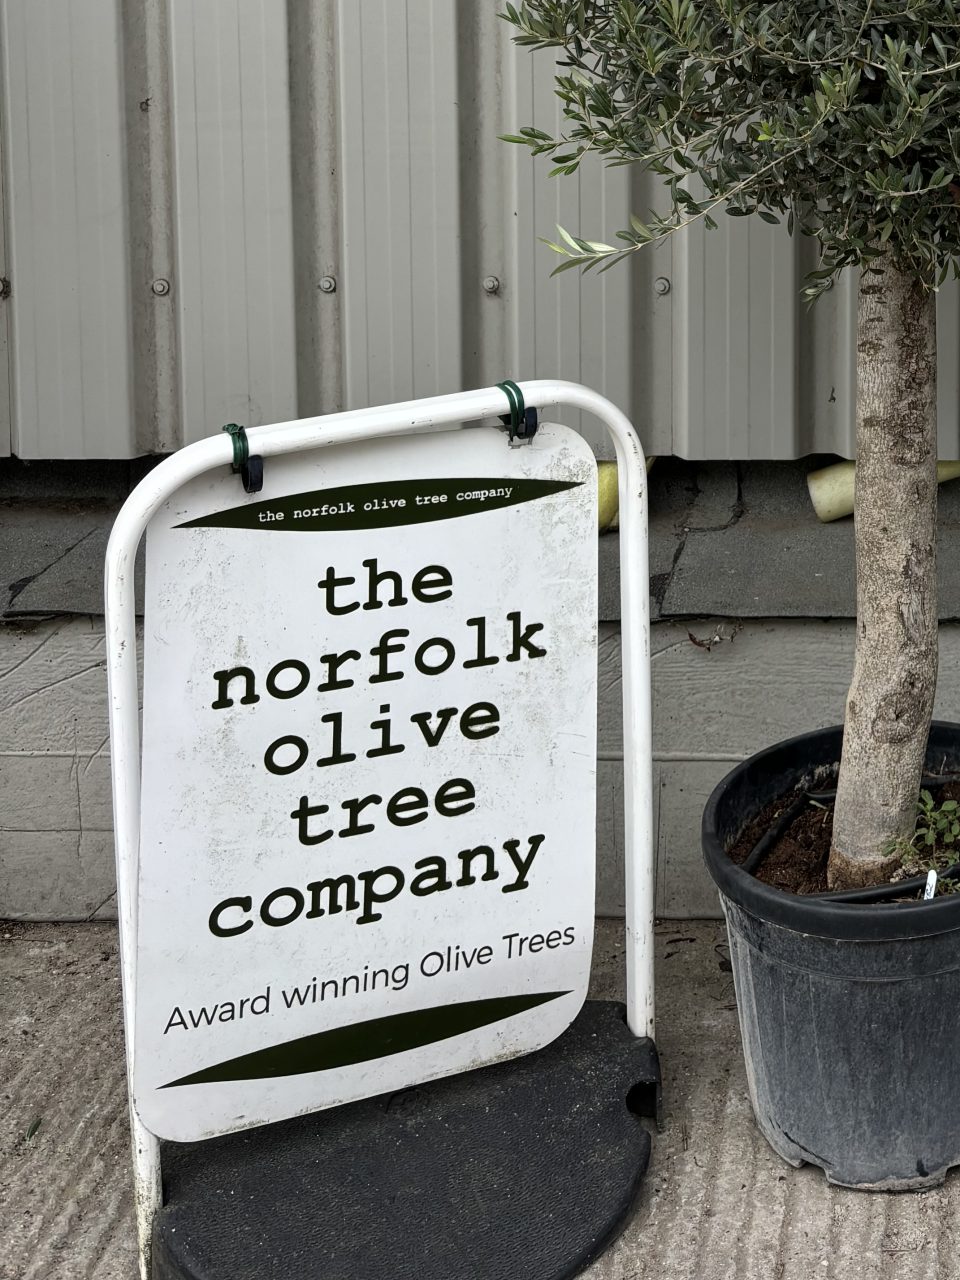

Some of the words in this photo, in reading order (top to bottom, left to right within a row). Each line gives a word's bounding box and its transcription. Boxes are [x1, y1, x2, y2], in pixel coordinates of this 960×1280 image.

[258, 510, 285, 522] the
[293, 502, 356, 519] norfolk
[363, 497, 407, 511] olive
[415, 494, 448, 506] tree
[455, 487, 513, 502] company
[318, 559, 453, 616] the
[211, 611, 548, 710] norfolk
[263, 701, 500, 776] olive
[290, 777, 476, 846] tree
[208, 833, 546, 938] company
[163, 986, 271, 1035] Award
[281, 963, 410, 1009] winning
[419, 945, 494, 978] Olive
[502, 926, 575, 959] Trees
